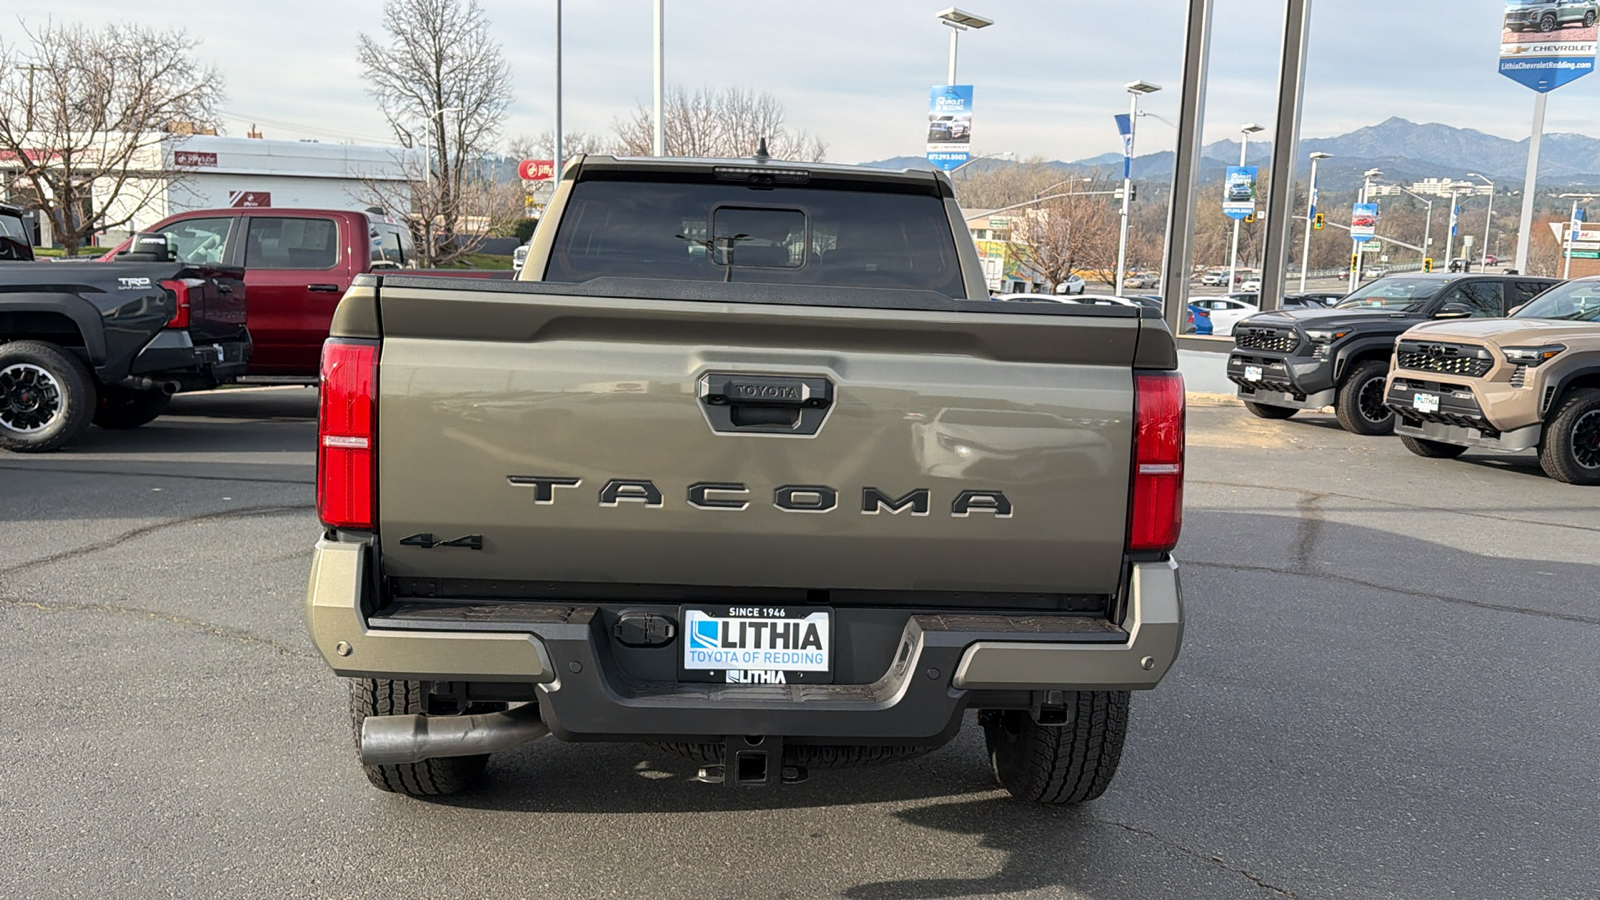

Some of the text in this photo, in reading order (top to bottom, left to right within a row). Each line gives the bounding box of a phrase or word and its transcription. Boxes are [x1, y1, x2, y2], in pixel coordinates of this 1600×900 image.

[1501, 61, 1592, 70] LithiaChevroletRedding.com
[117, 277, 151, 286] TRD
[735, 384, 799, 398] TOYOTA
[507, 474, 1014, 519] TACOMA
[729, 607, 786, 617] SINCE 1946
[721, 621, 823, 650] LITHIA
[690, 650, 823, 665] TOYOTA OF REDDING
[739, 670, 787, 684] LITHIA
